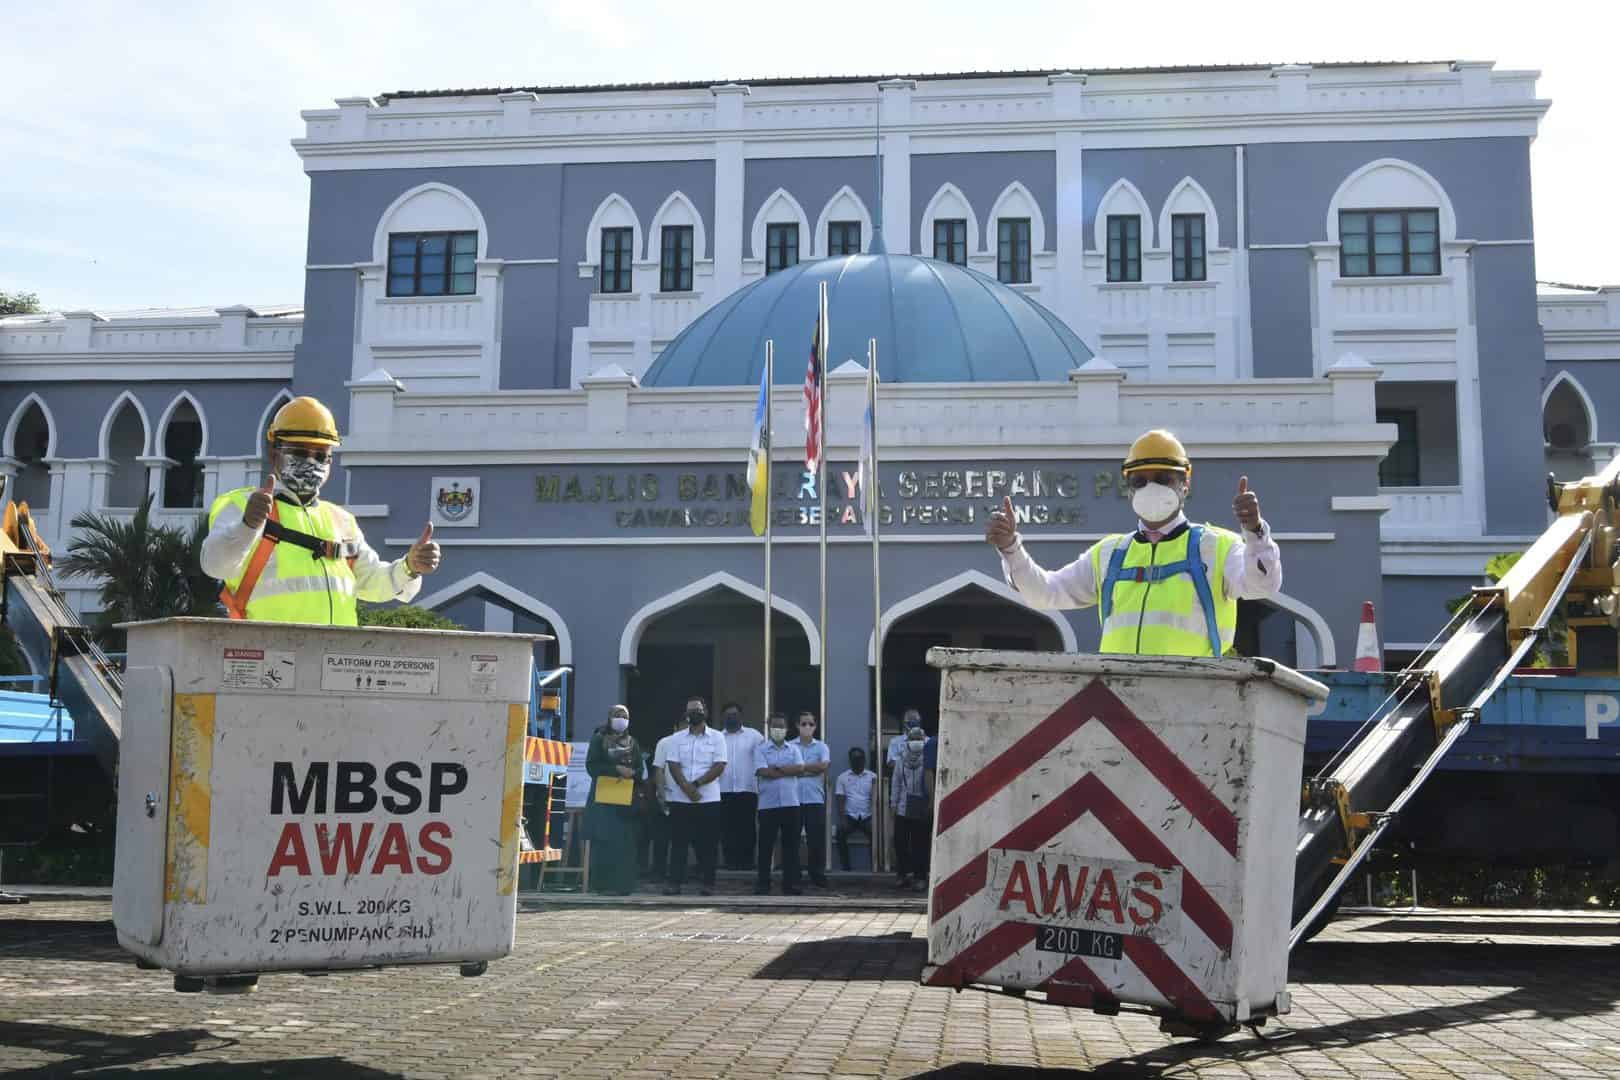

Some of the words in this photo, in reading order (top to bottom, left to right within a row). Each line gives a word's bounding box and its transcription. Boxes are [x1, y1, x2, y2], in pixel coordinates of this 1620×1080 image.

[535, 472, 657, 503] MAJLIS
[679, 471, 887, 501] BANARAY
[897, 467, 1079, 498] SEBERANG
[769, 506, 894, 526] EBERAG
[327, 657, 372, 668] PLATFORM
[374, 659, 391, 669] FOR
[270, 761, 468, 815] MBSP
[266, 821, 453, 876] AWAS
[997, 859, 1163, 926] AWAS
[298, 901, 352, 917] S.W.L.
[270, 929, 280, 944] 2
[1043, 928, 1080, 952] 200
[1091, 936, 1115, 956] KG
